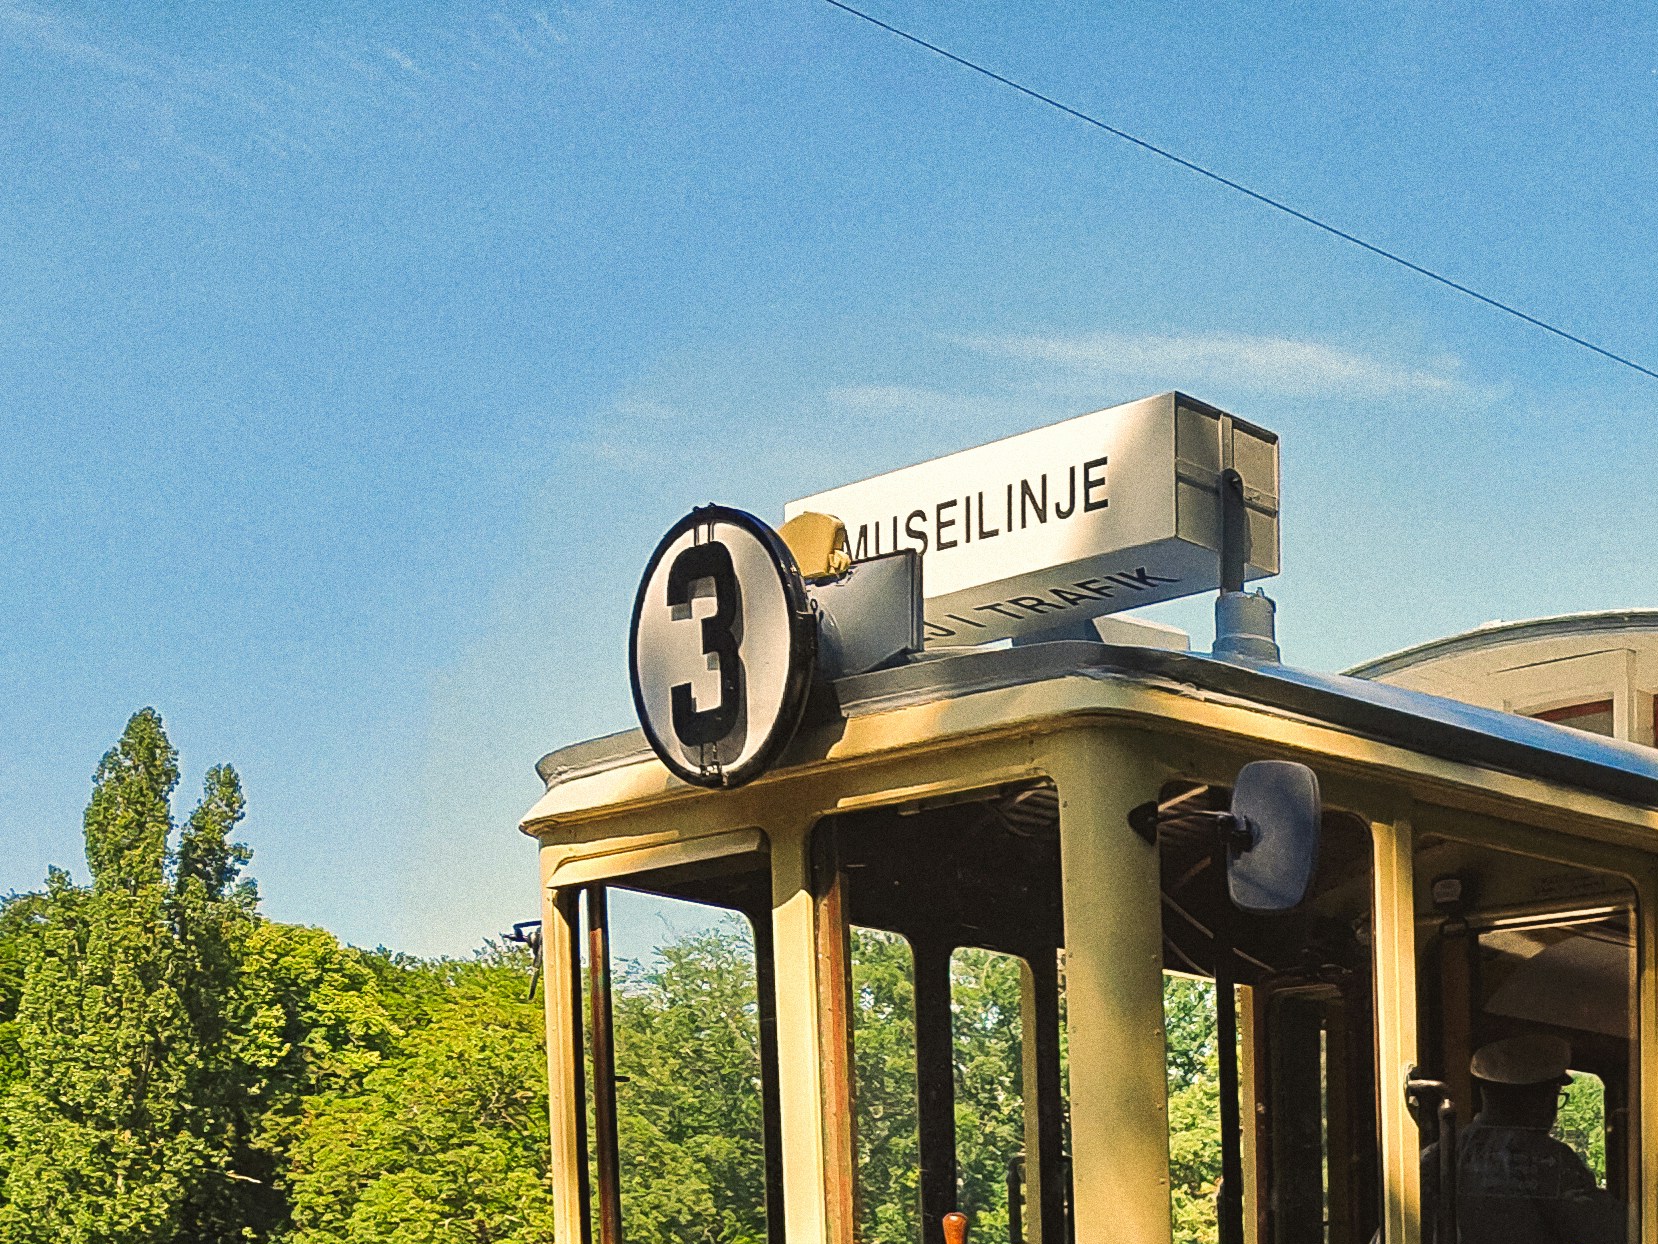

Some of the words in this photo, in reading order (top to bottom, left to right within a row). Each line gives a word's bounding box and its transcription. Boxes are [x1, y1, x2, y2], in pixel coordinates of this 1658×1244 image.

[843, 456, 1109, 556] MUSEILINJE
[973, 566, 1180, 620] TRAFIK
[667, 541, 742, 750] 3
